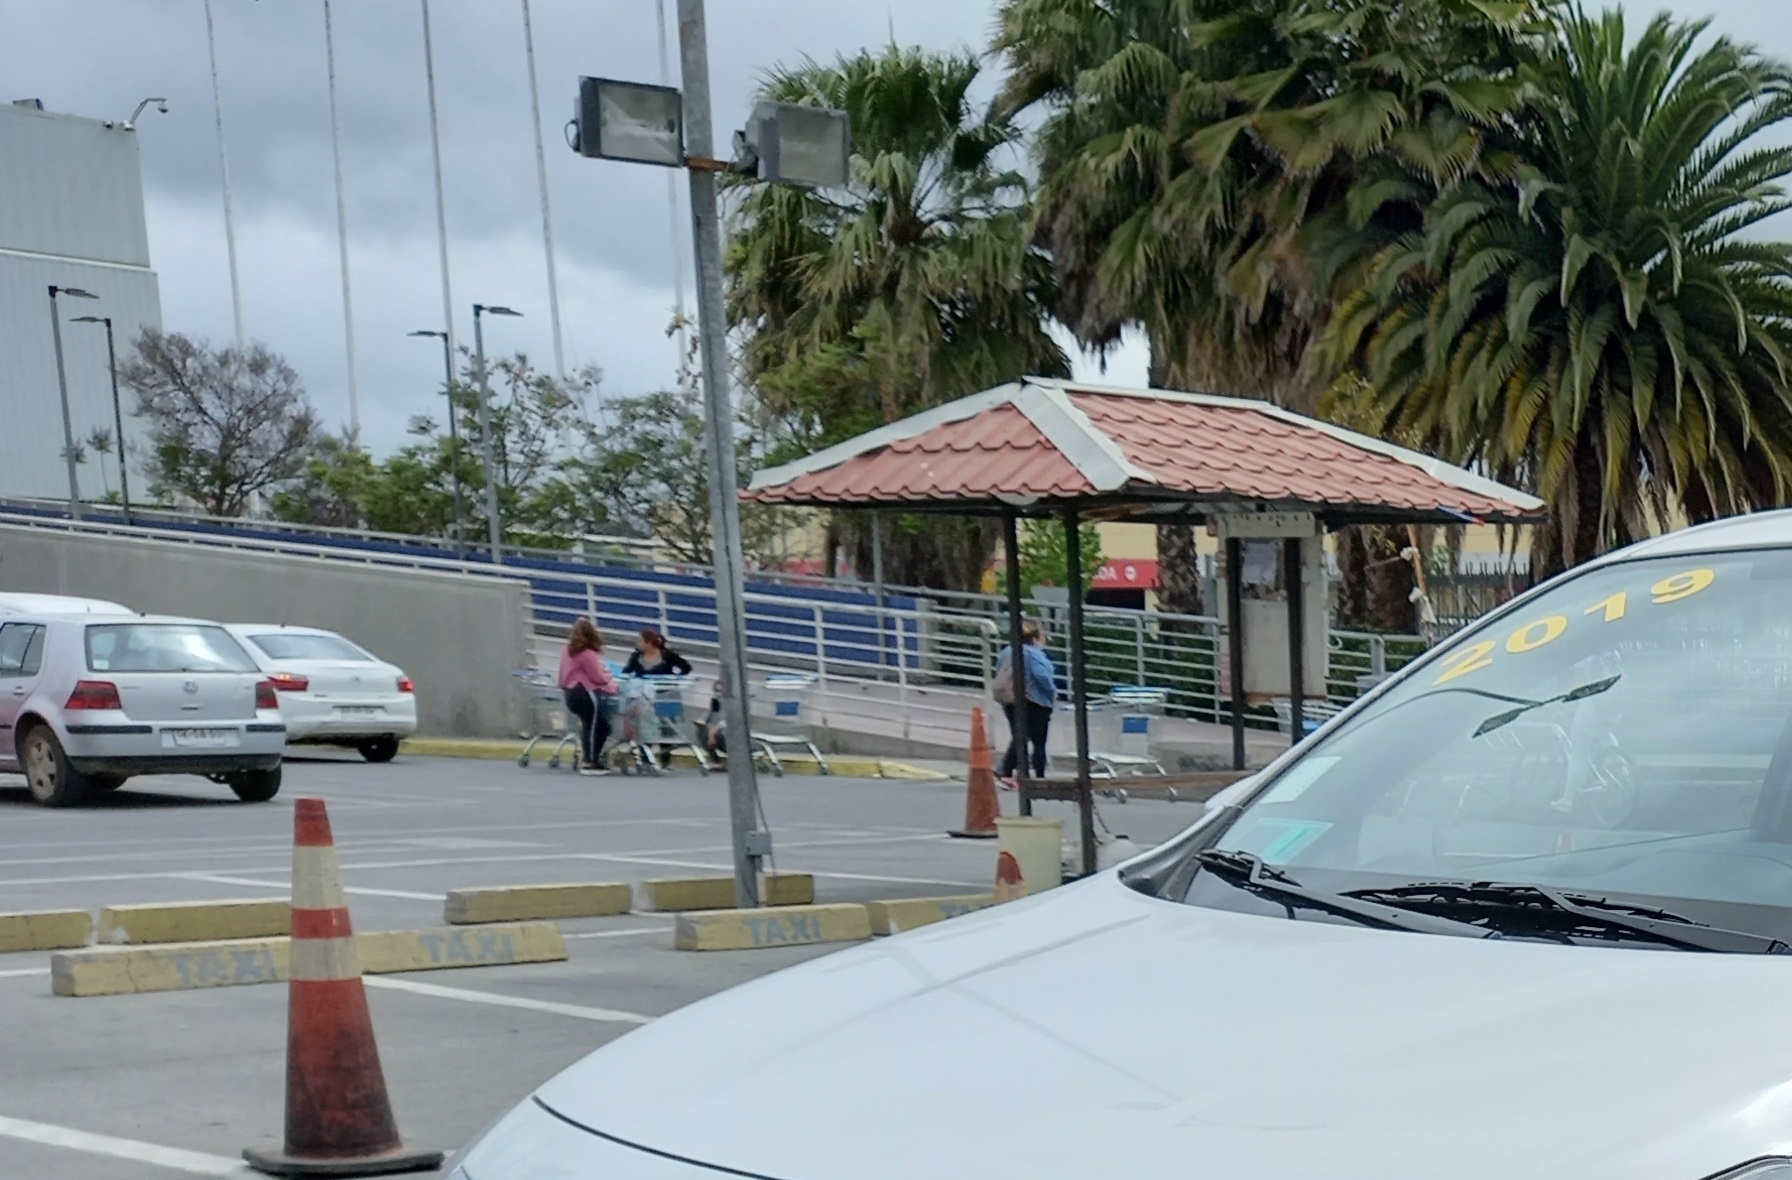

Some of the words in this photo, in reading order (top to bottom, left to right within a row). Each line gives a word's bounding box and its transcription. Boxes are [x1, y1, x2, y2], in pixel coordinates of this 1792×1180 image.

[1432, 568, 1715, 686] 2019
[738, 912, 822, 945] TAXI
[417, 930, 514, 963] TAXI
[167, 948, 276, 985] TAXI
